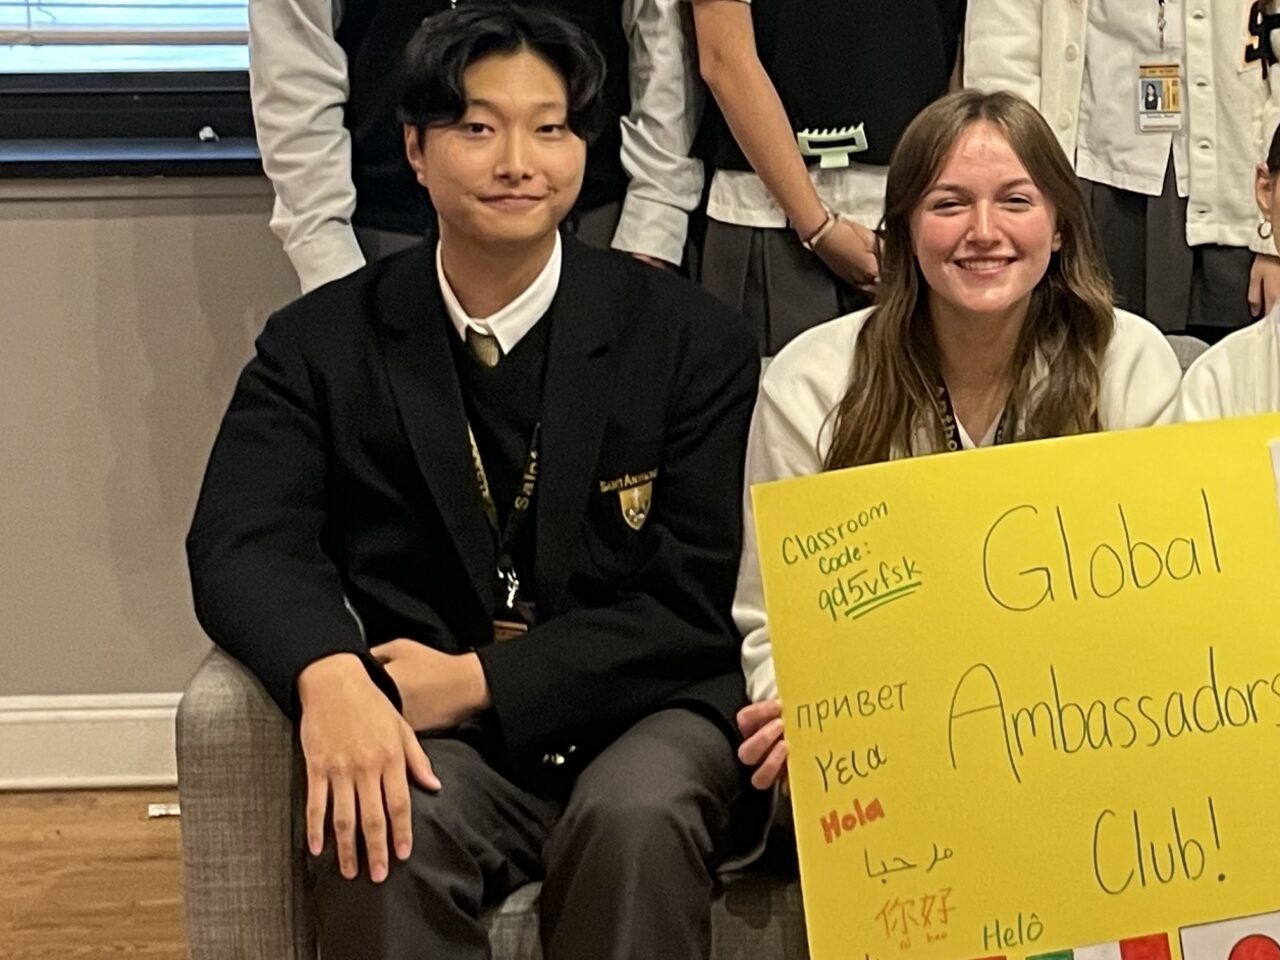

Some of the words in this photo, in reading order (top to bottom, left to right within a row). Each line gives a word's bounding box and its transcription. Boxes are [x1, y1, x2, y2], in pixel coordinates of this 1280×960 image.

[782, 501, 889, 566] Classroom
[819, 541, 872, 576] code:
[983, 488, 1221, 611] Global
[820, 798, 885, 844] Hola
[1093, 796, 1226, 895] Club!
[874, 887, 956, 938] 你好
